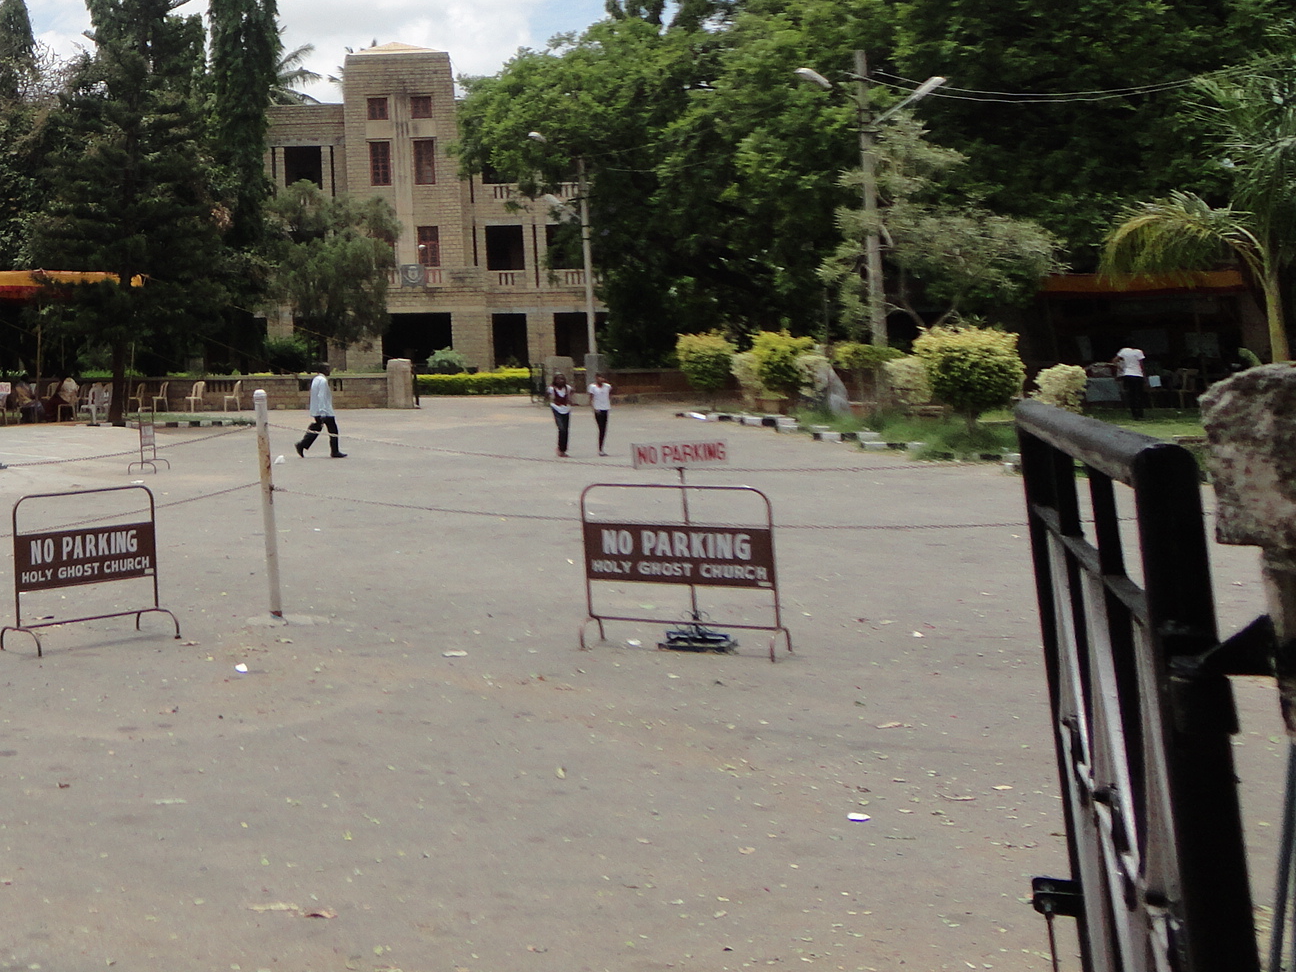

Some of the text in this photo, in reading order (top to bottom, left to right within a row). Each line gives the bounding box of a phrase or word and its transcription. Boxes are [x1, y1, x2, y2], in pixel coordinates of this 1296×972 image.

[636, 442, 726, 464] NO PARKING
[30, 530, 138, 565] NO PARKING
[601, 529, 752, 560] NO PARKING
[21, 556, 150, 584] HOLY GHOST CHURCH
[591, 559, 767, 580] HOLY GHOST CHURCH
